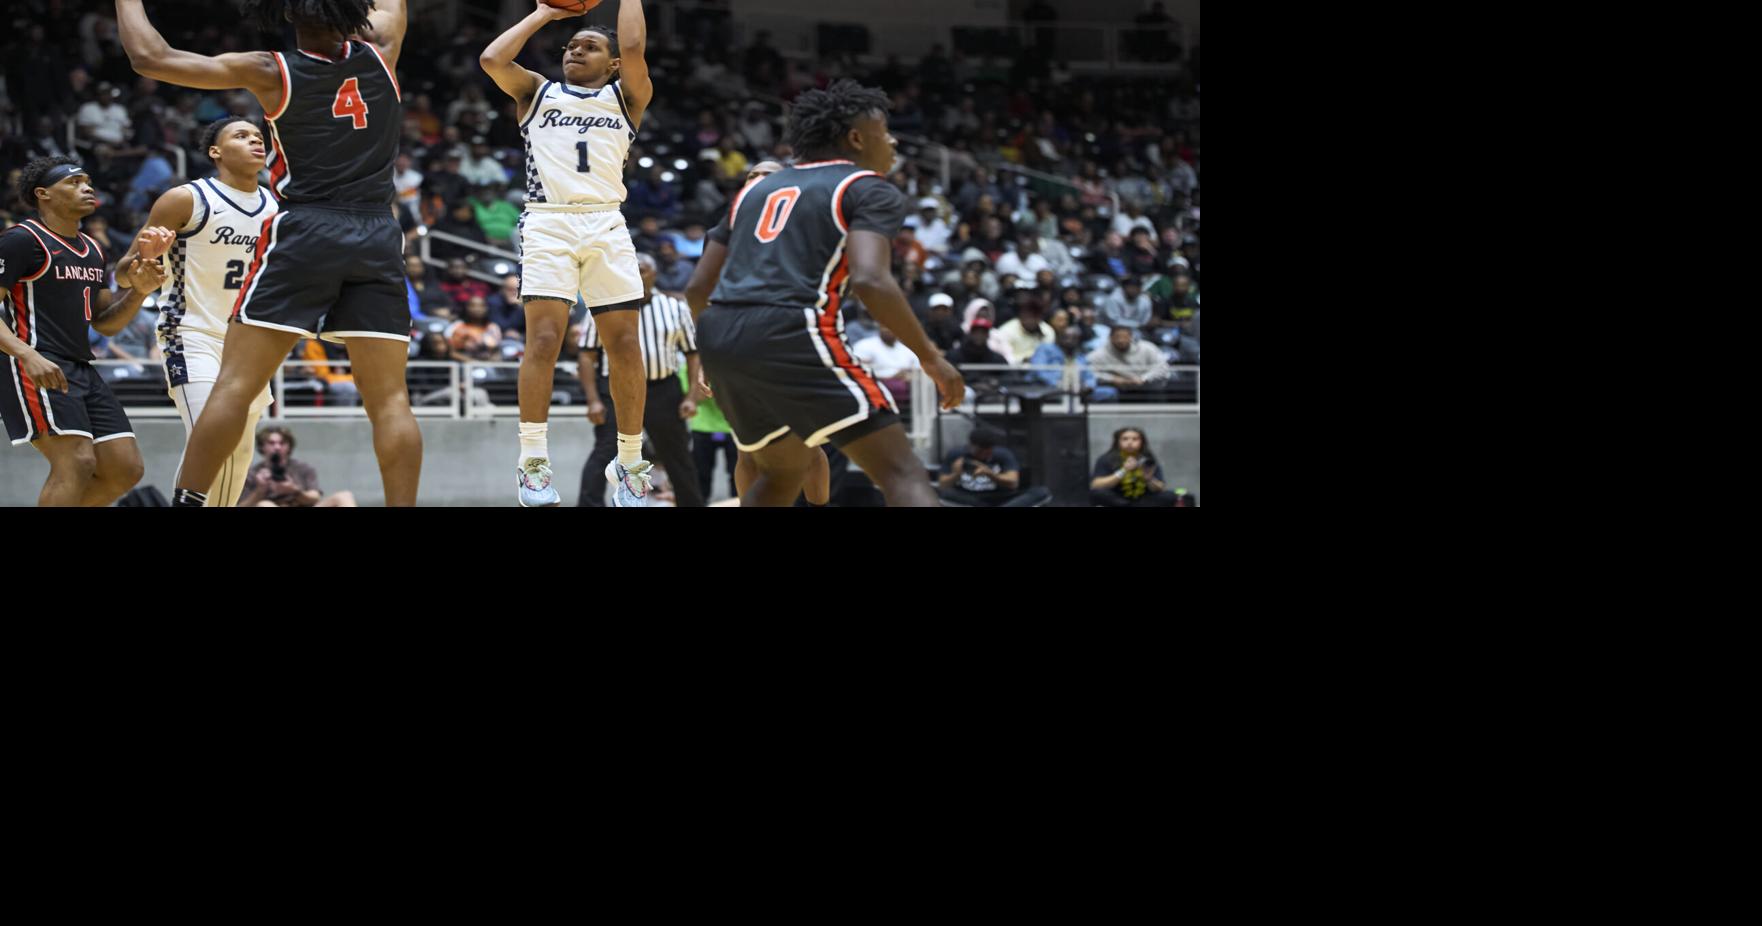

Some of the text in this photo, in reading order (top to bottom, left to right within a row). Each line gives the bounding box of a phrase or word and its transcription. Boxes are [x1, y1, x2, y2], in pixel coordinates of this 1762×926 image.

[332, 77, 368, 129] 4
[539, 109, 622, 134] Rangers
[576, 141, 590, 173] 1
[754, 186, 801, 243] 0
[224, 259, 256, 289] 2
[83, 286, 92, 321] 1
